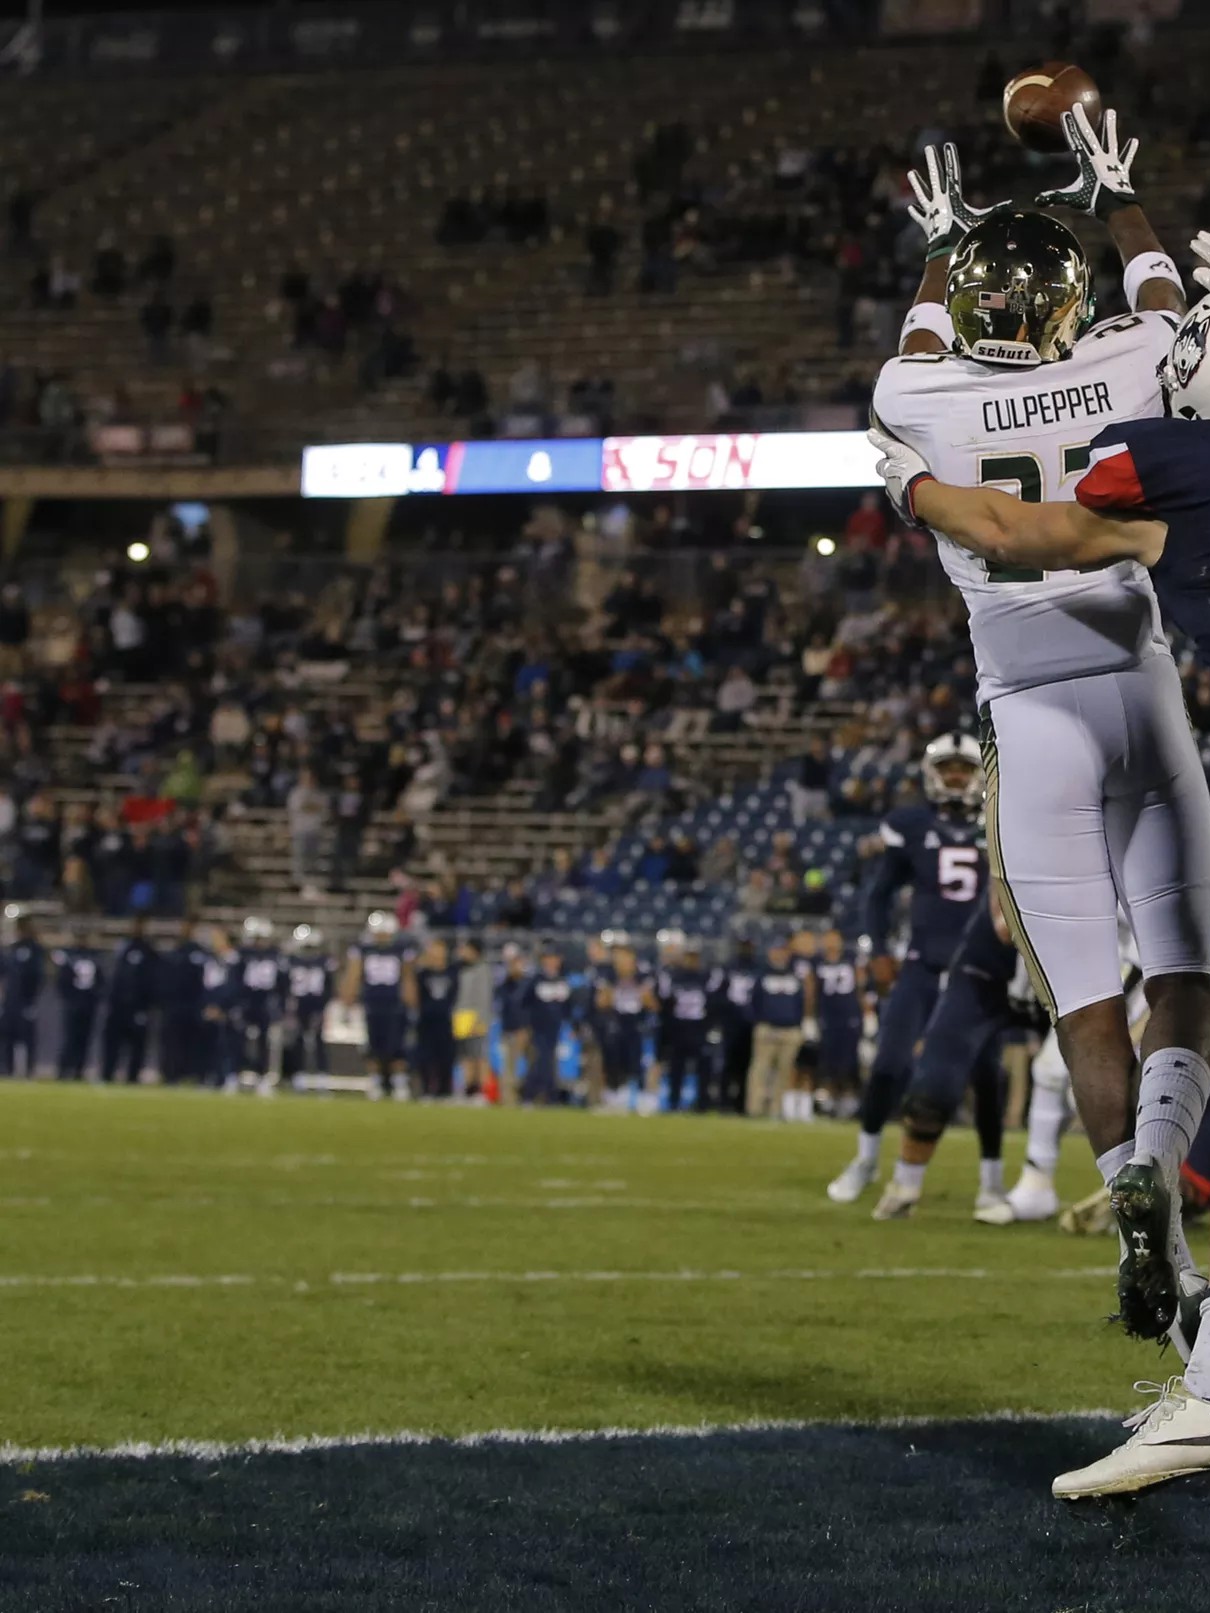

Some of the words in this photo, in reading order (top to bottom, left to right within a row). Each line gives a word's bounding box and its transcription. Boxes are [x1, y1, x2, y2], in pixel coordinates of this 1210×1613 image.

[977, 345, 1032, 361] schutt
[982, 381, 1113, 432] CULPEPPER
[652, 443, 757, 482] SON
[938, 846, 979, 902] 5
